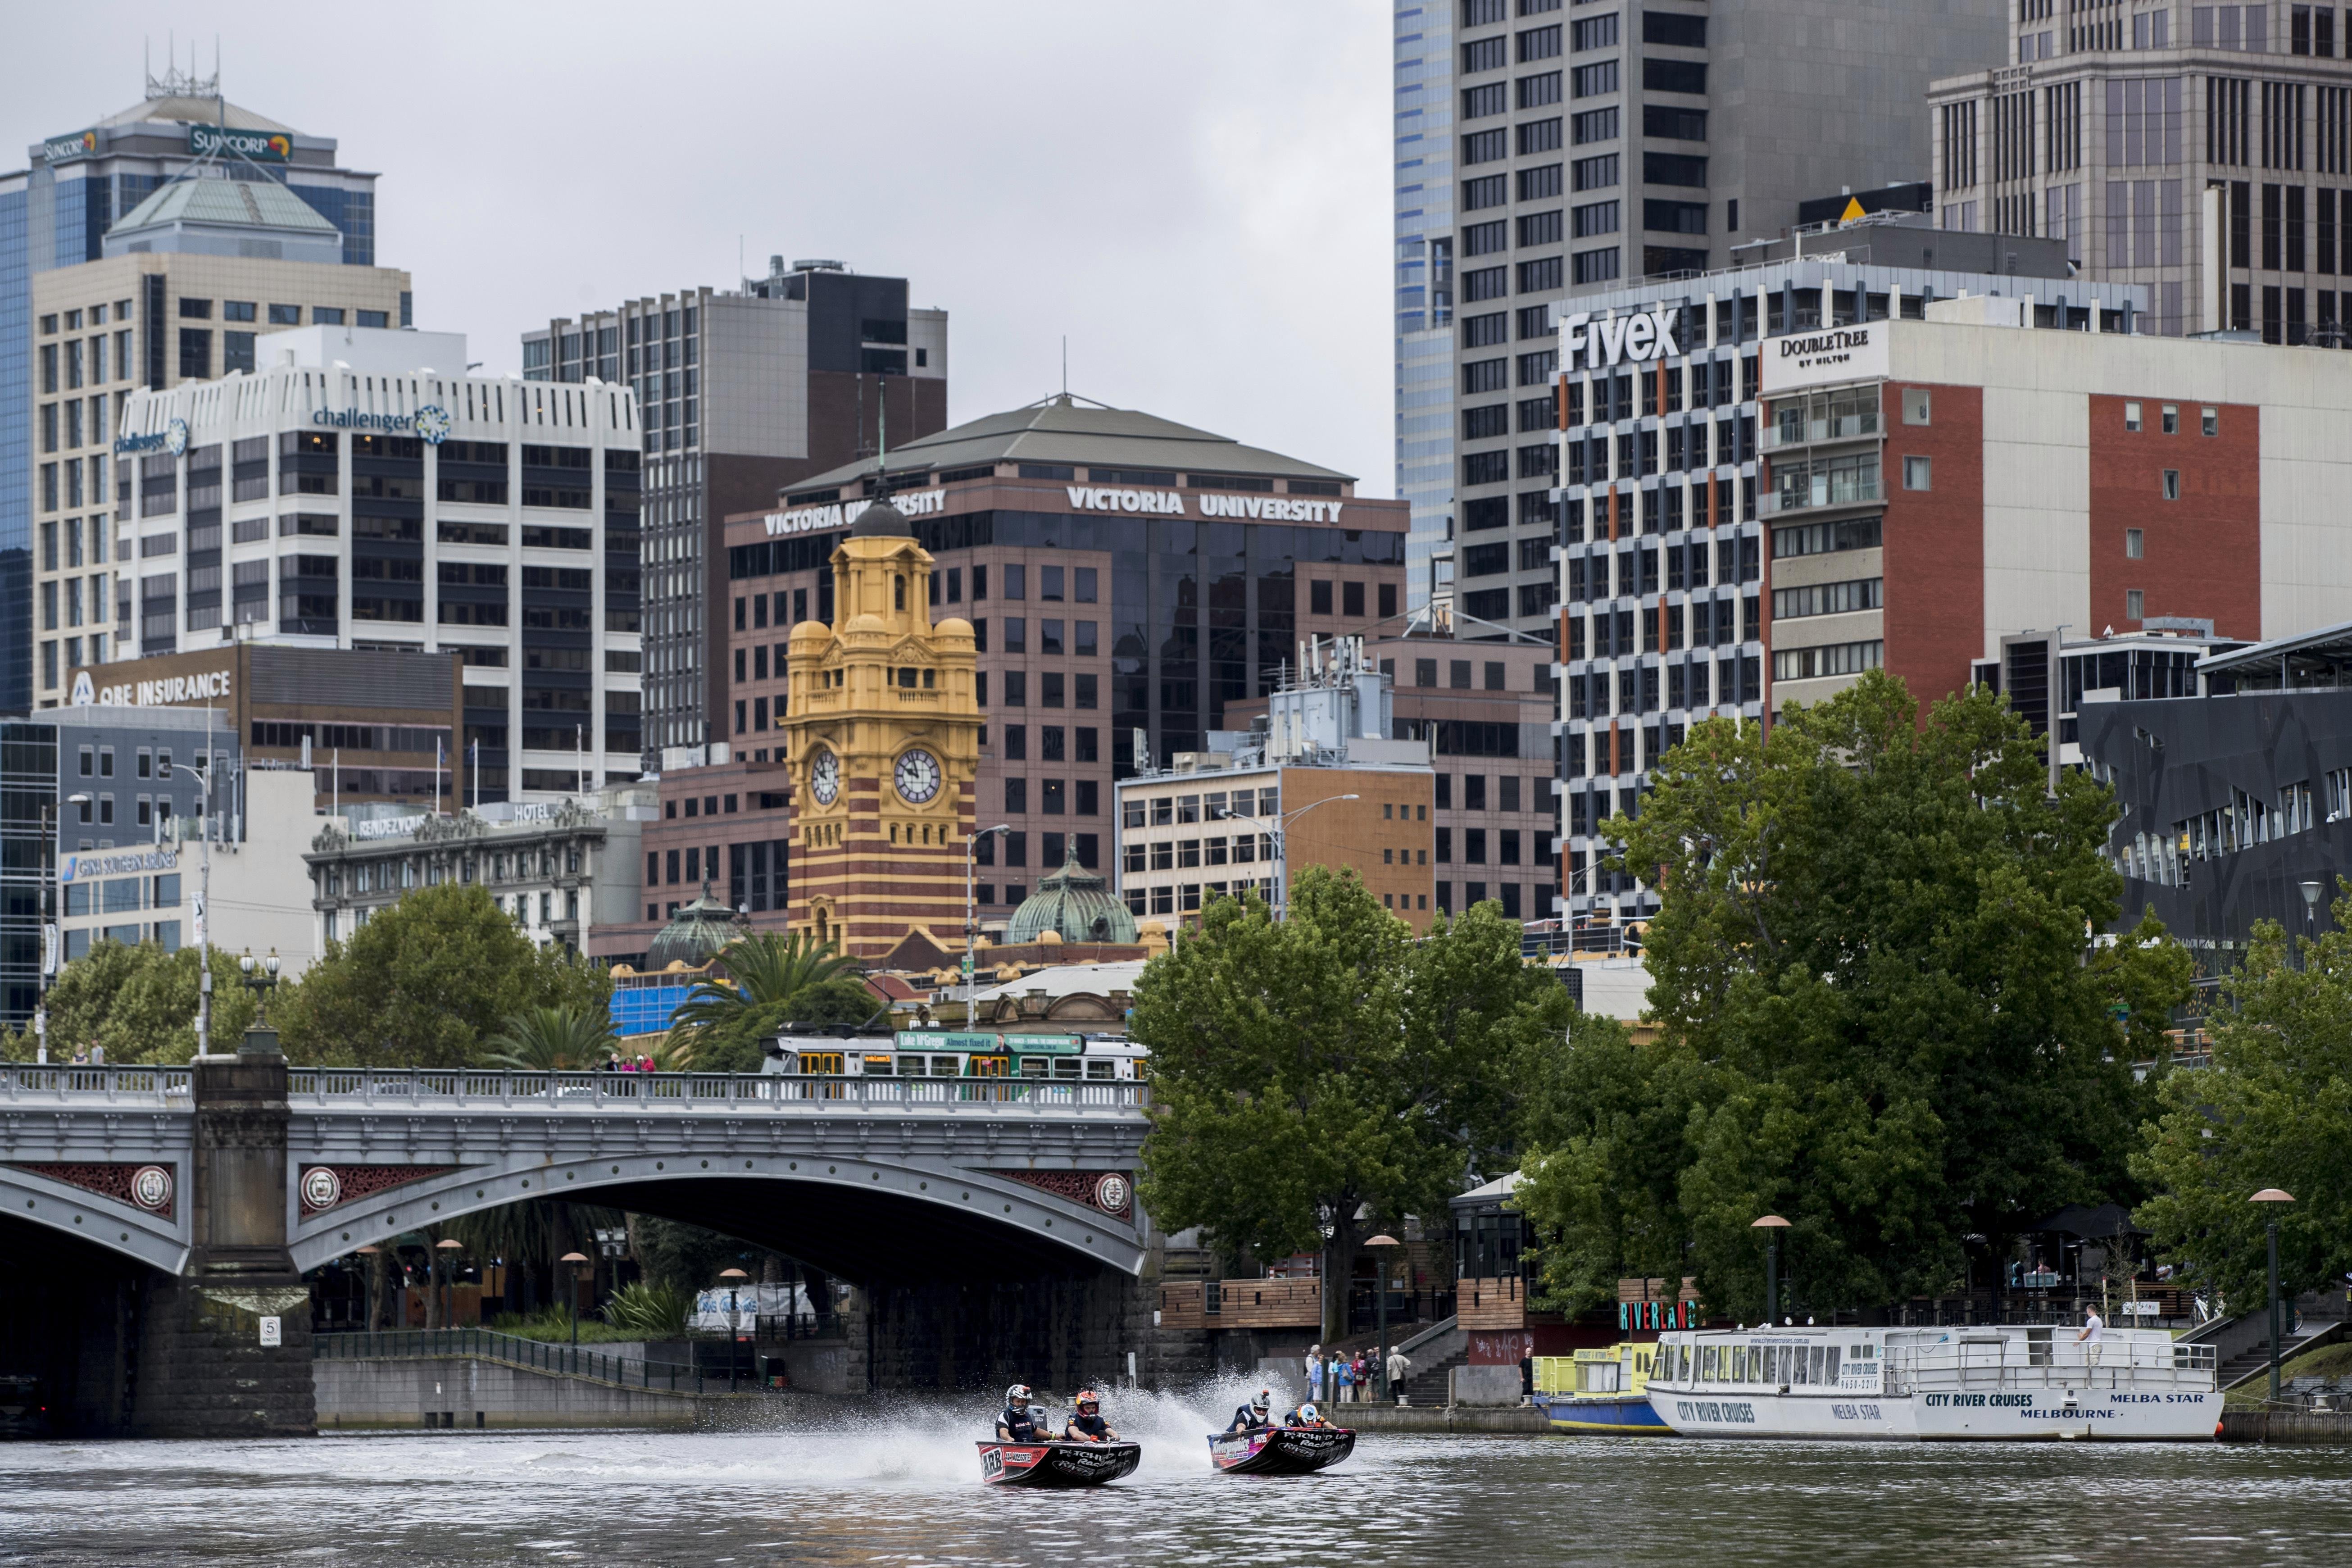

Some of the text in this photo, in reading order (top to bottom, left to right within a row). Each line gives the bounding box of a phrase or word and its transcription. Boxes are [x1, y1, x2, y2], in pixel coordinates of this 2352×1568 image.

[45, 139, 84, 161] SUNCORP
[194, 130, 268, 154] SUNCORP
[1799, 354, 1850, 368] BY HILTON
[314, 406, 413, 433] challenger
[1066, 486, 1343, 523] VICTORIA UNIVERSITY
[764, 504, 842, 536] VICTORIA
[100, 670, 231, 706] QBE INSURANCE
[515, 803, 549, 821] HOTEL
[78, 858, 102, 877] CHINA
[103, 854, 143, 874] SOUTHERN
[901, 1034, 915, 1046] Luke
[947, 1038, 967, 1046] Almost
[970, 1038, 985, 1047] fixed
[985, 1039, 990, 1047] it
[1621, 1301, 1696, 1330] RIVERLAND
[267, 1322, 274, 1333] 5
[1750, 1337, 1810, 1345] www.cityrivercruises.com.au
[1842, 1363, 1878, 1375] CITY RIVER CRUISES
[1926, 1394, 2033, 1407] CITY RIVER CRUISES
[2110, 1394, 2204, 1403] MELBA STAR
[1677, 1401, 1755, 1423] CITY RIVER CRUISES
[1831, 1404, 1881, 1420] MELBA STAR
[2021, 1409, 2116, 1418] MELBOURNE
[1300, 1440, 1335, 1448] Racing
[983, 1449, 1003, 1478] ARB
[1077, 1458, 1116, 1467] Racing
